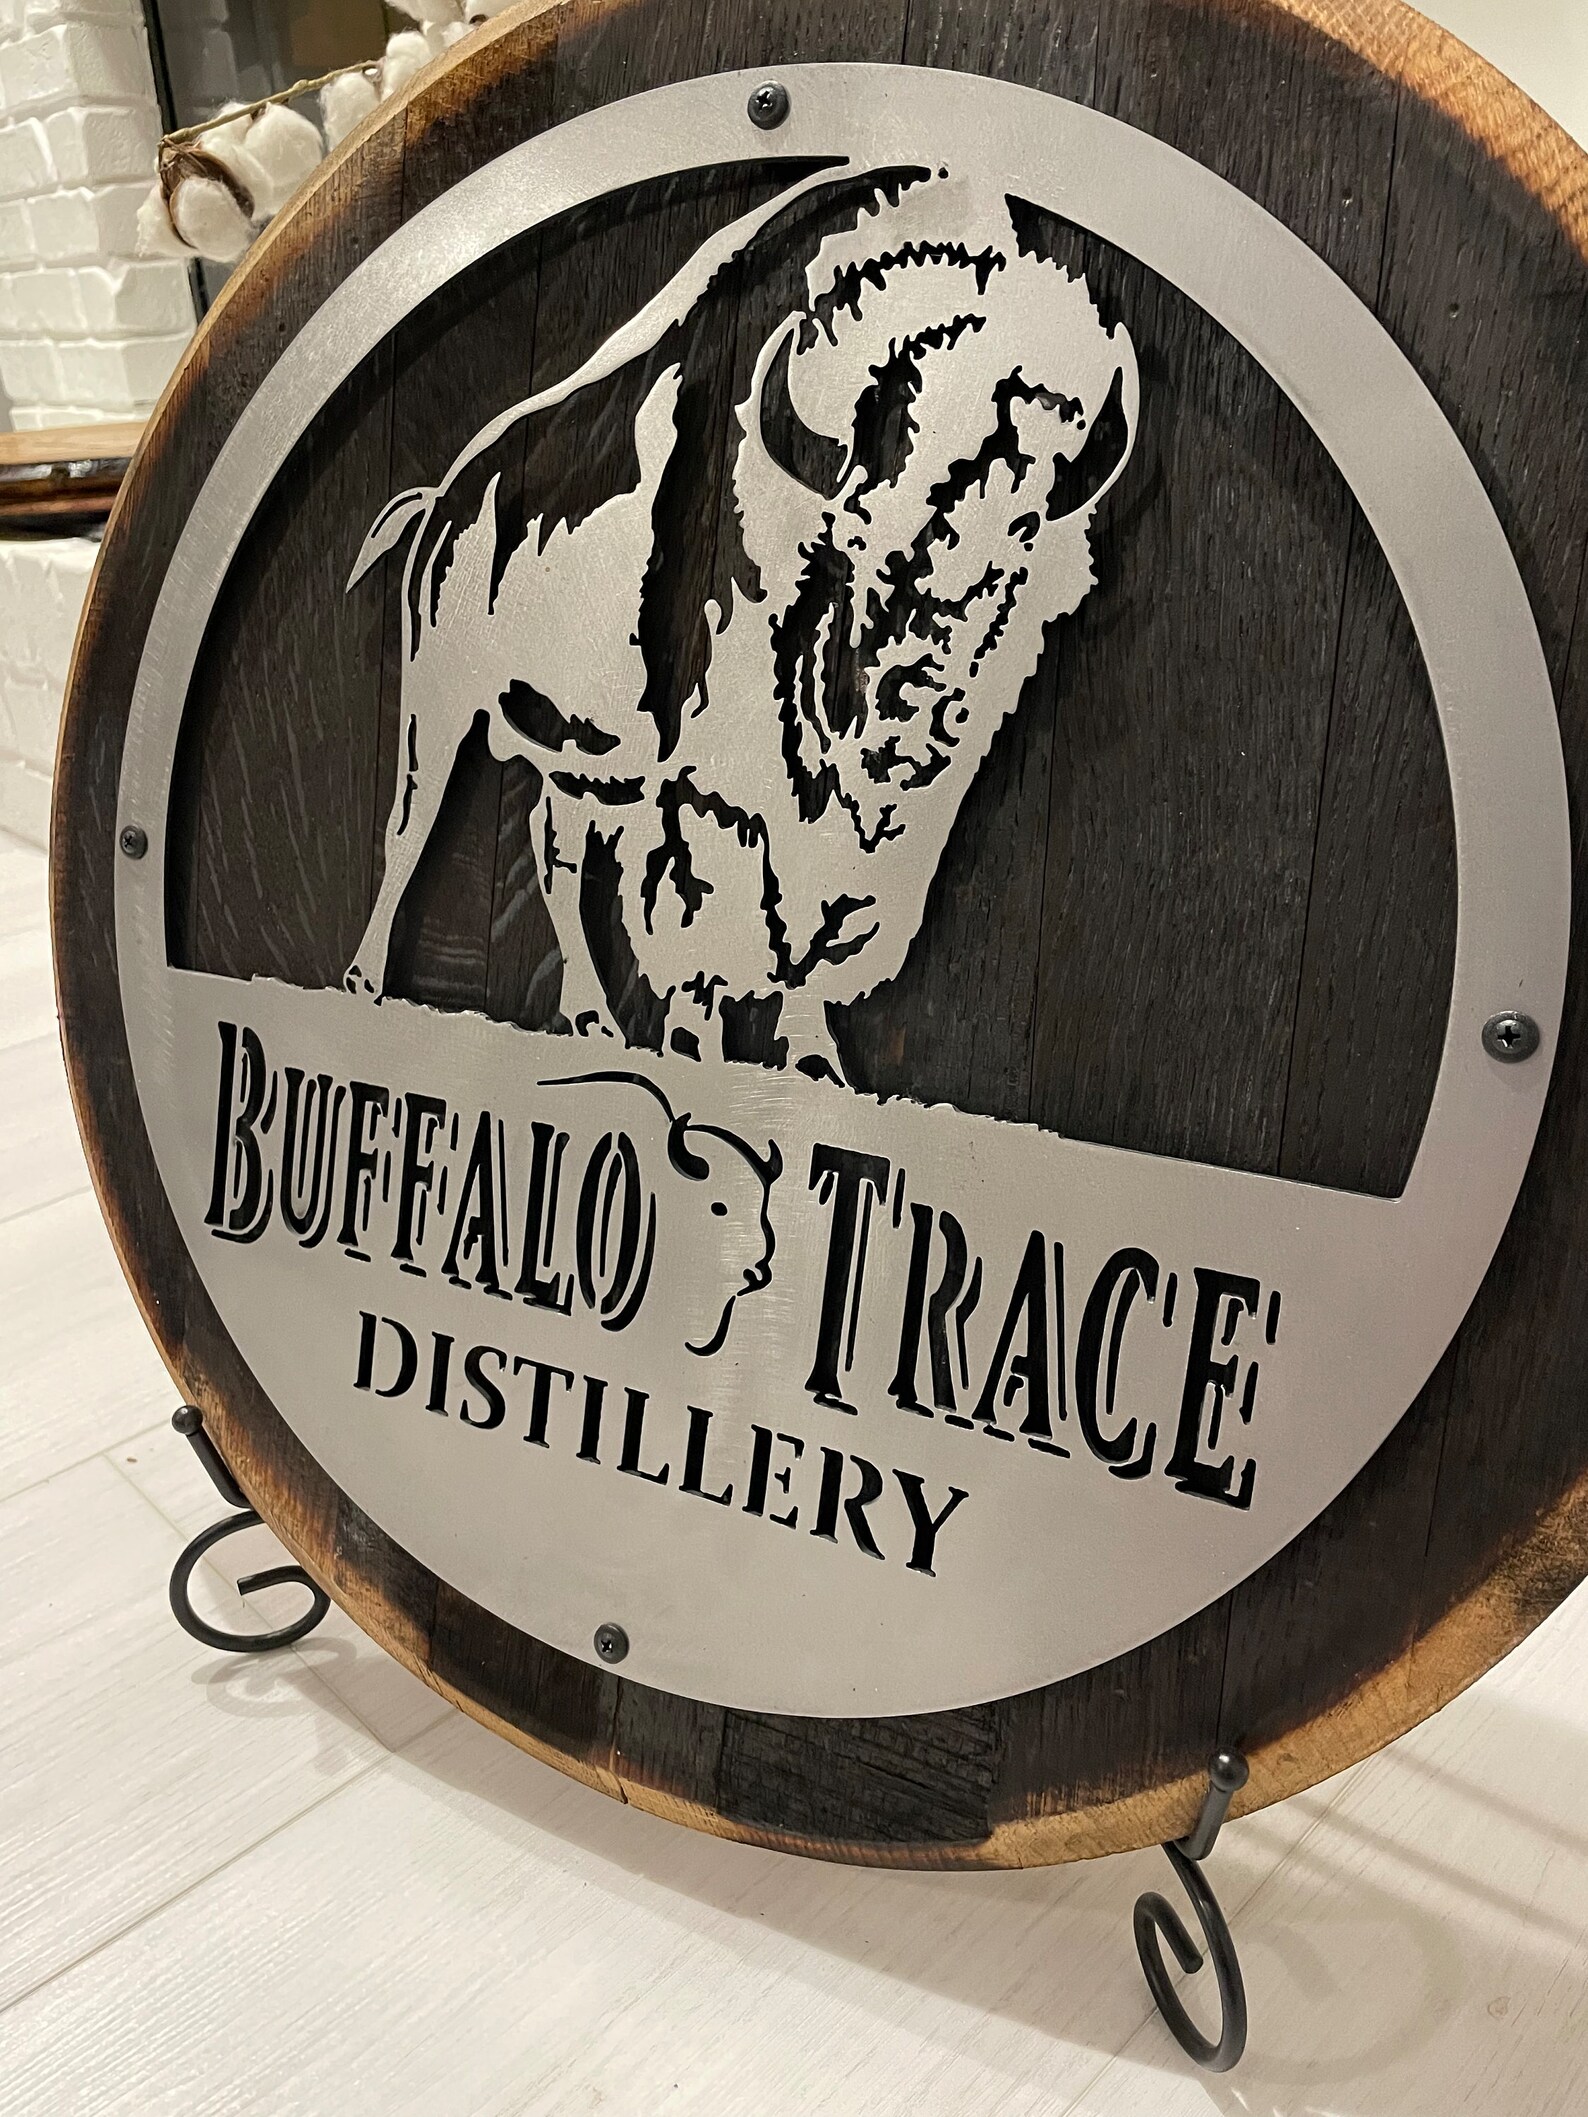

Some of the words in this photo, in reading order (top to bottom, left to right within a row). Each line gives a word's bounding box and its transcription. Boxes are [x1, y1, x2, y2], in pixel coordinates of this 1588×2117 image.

[204, 1021, 656, 1332] BUFFALO
[804, 1142, 1281, 1511] TRACE
[353, 1310, 969, 1577] DISTILLERY
